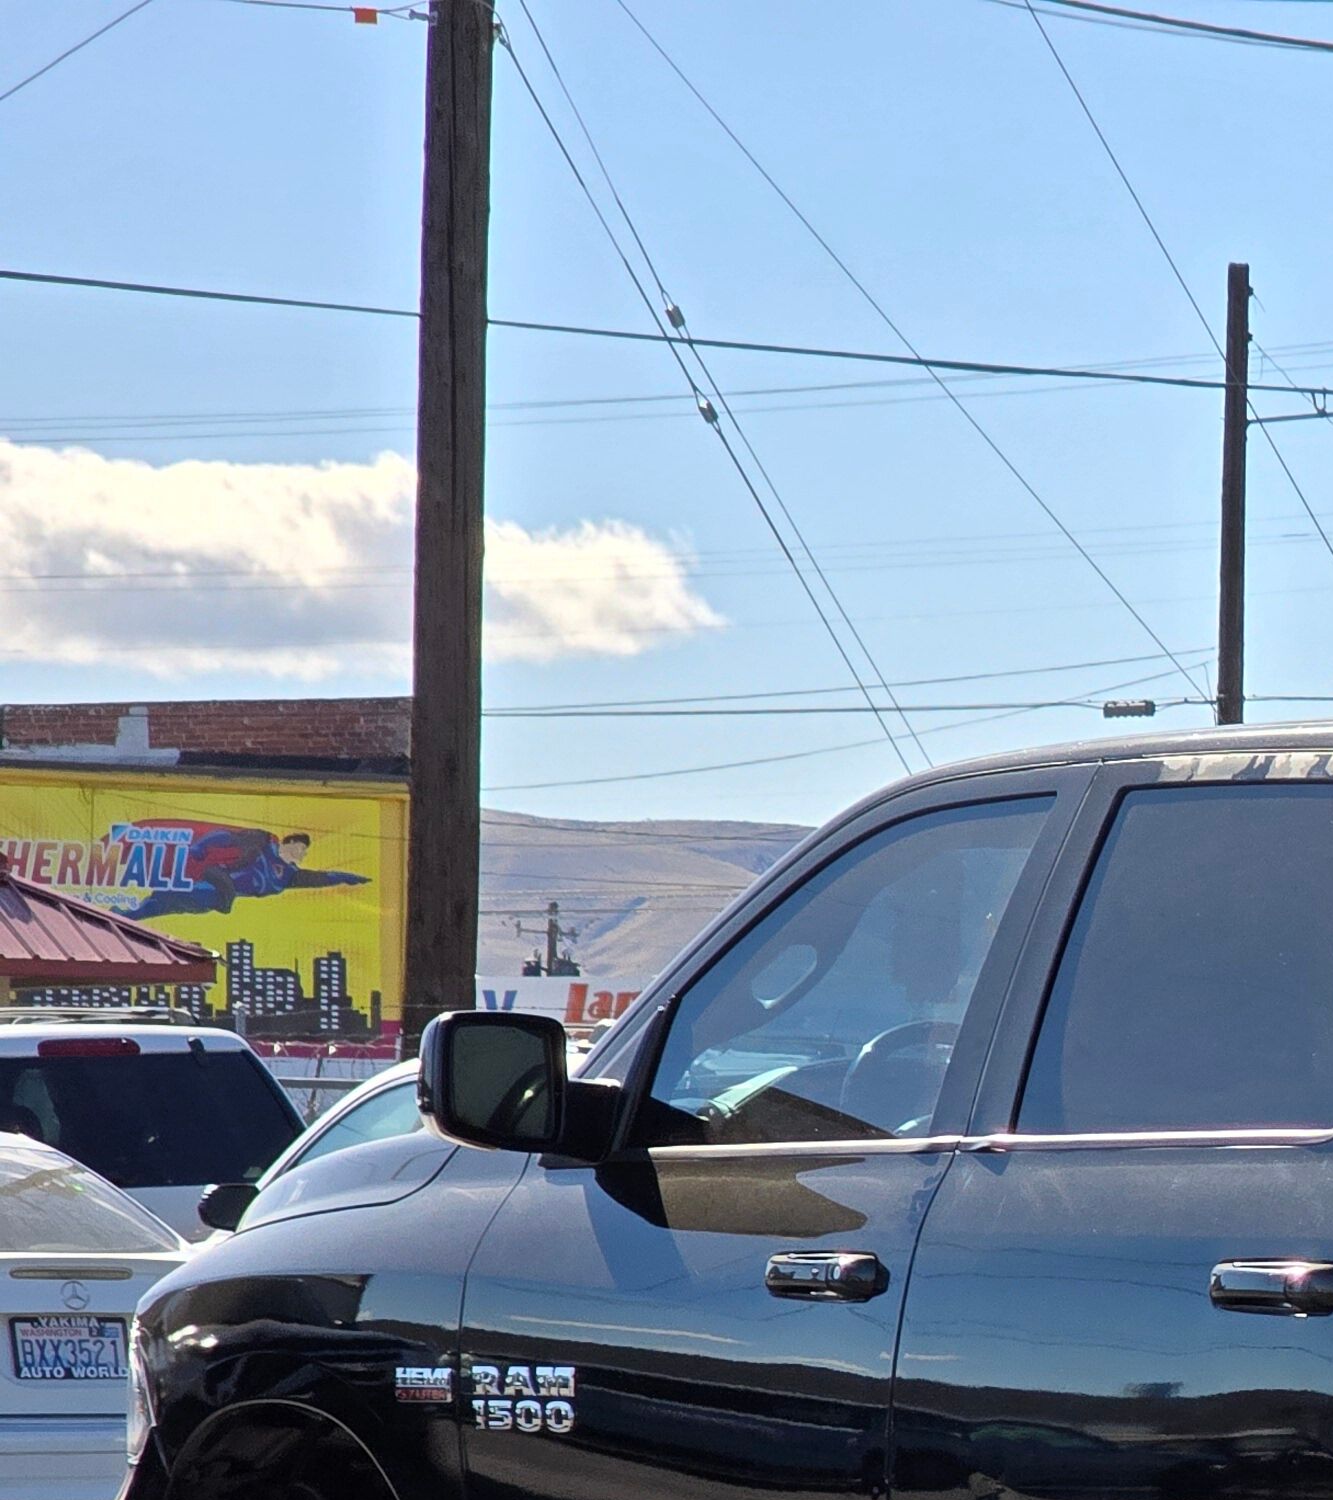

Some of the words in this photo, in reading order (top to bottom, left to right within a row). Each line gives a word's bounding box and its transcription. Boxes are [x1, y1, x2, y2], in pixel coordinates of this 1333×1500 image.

[127, 828, 192, 842] DAIKIN
[0, 840, 193, 889] HERMALL
[94, 891, 139, 911] Cooling
[38, 1316, 100, 1328] YAKIMA
[20, 1328, 82, 1338] WASHINGTON
[20, 1366, 65, 1378] AUTO
[71, 1366, 129, 1378] WORLD
[471, 1365, 575, 1397] RAM
[471, 1399, 574, 1433] 1500
